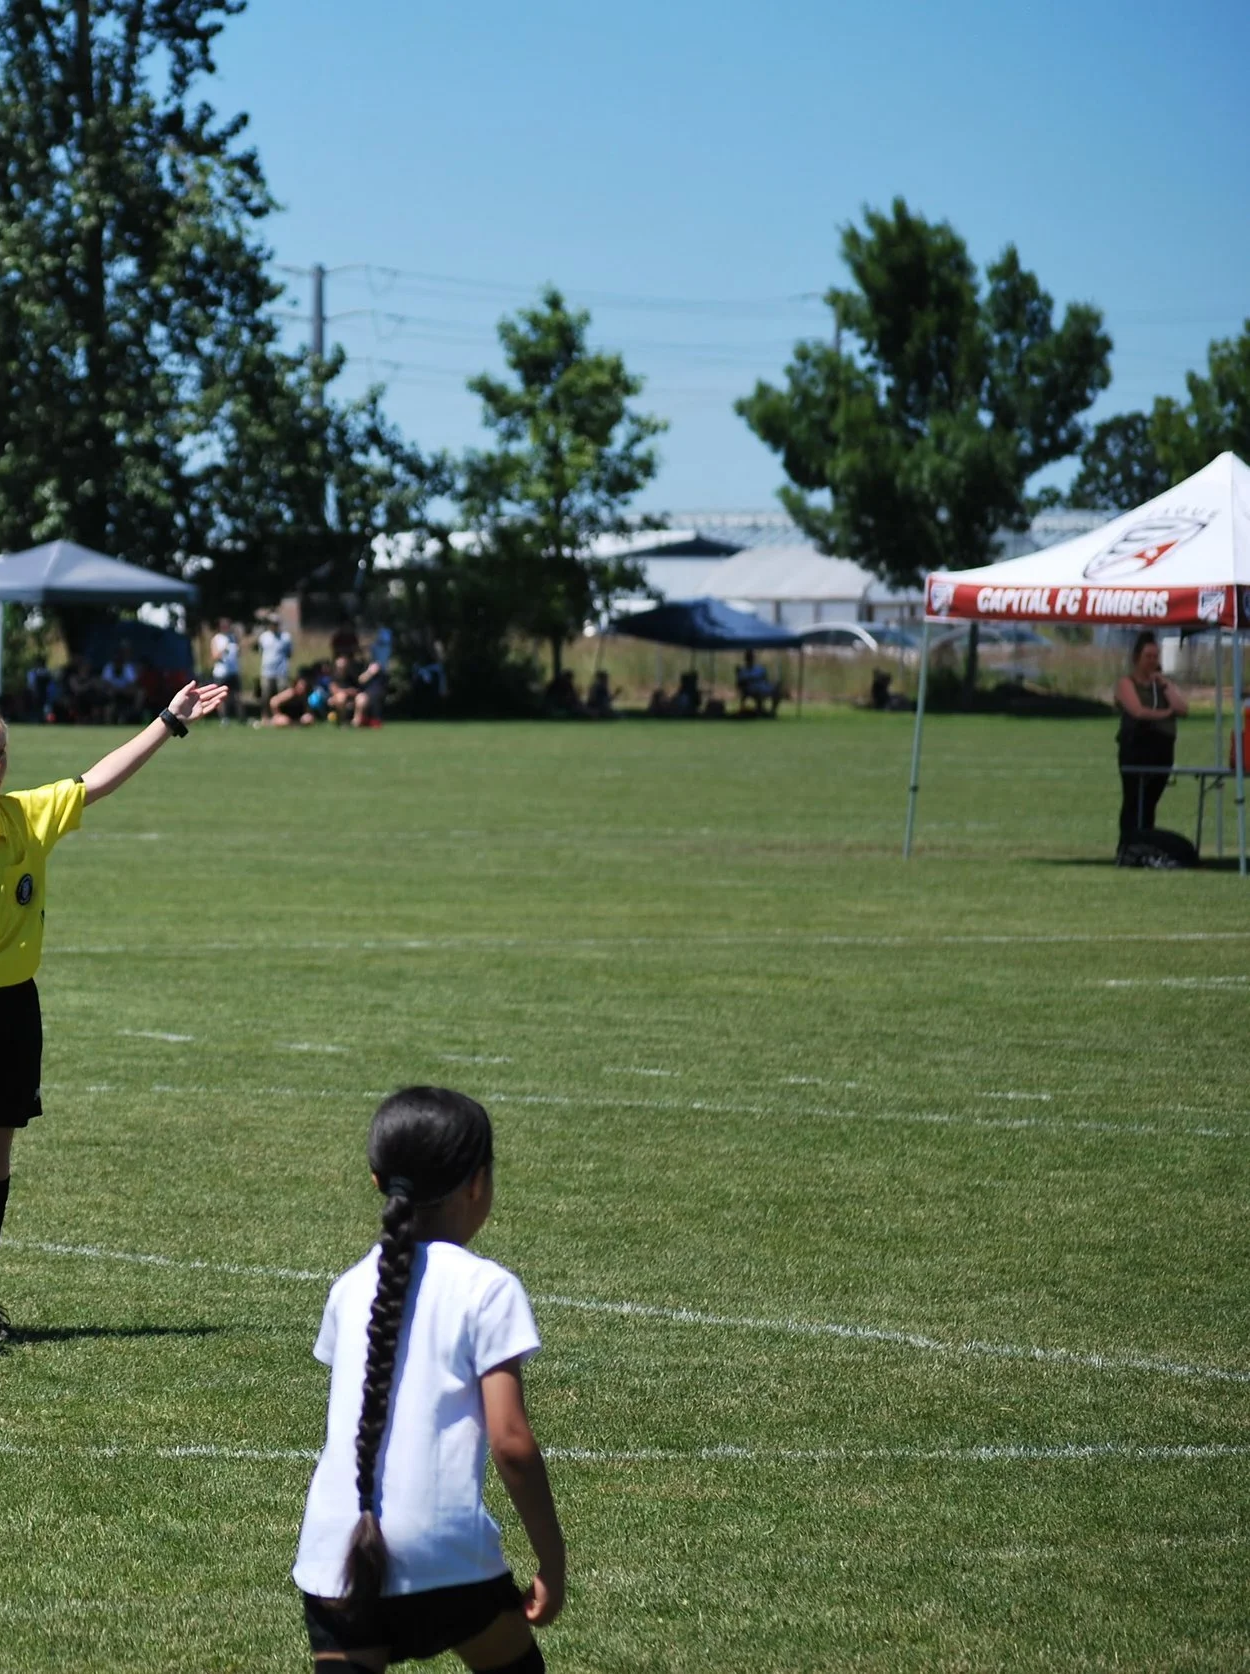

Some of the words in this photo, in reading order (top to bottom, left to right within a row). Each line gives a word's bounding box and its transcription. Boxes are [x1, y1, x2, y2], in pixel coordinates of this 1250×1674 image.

[976, 587, 1050, 615] CAPITAL
[1054, 587, 1083, 616] FC
[1085, 589, 1170, 618] TIMBERS
